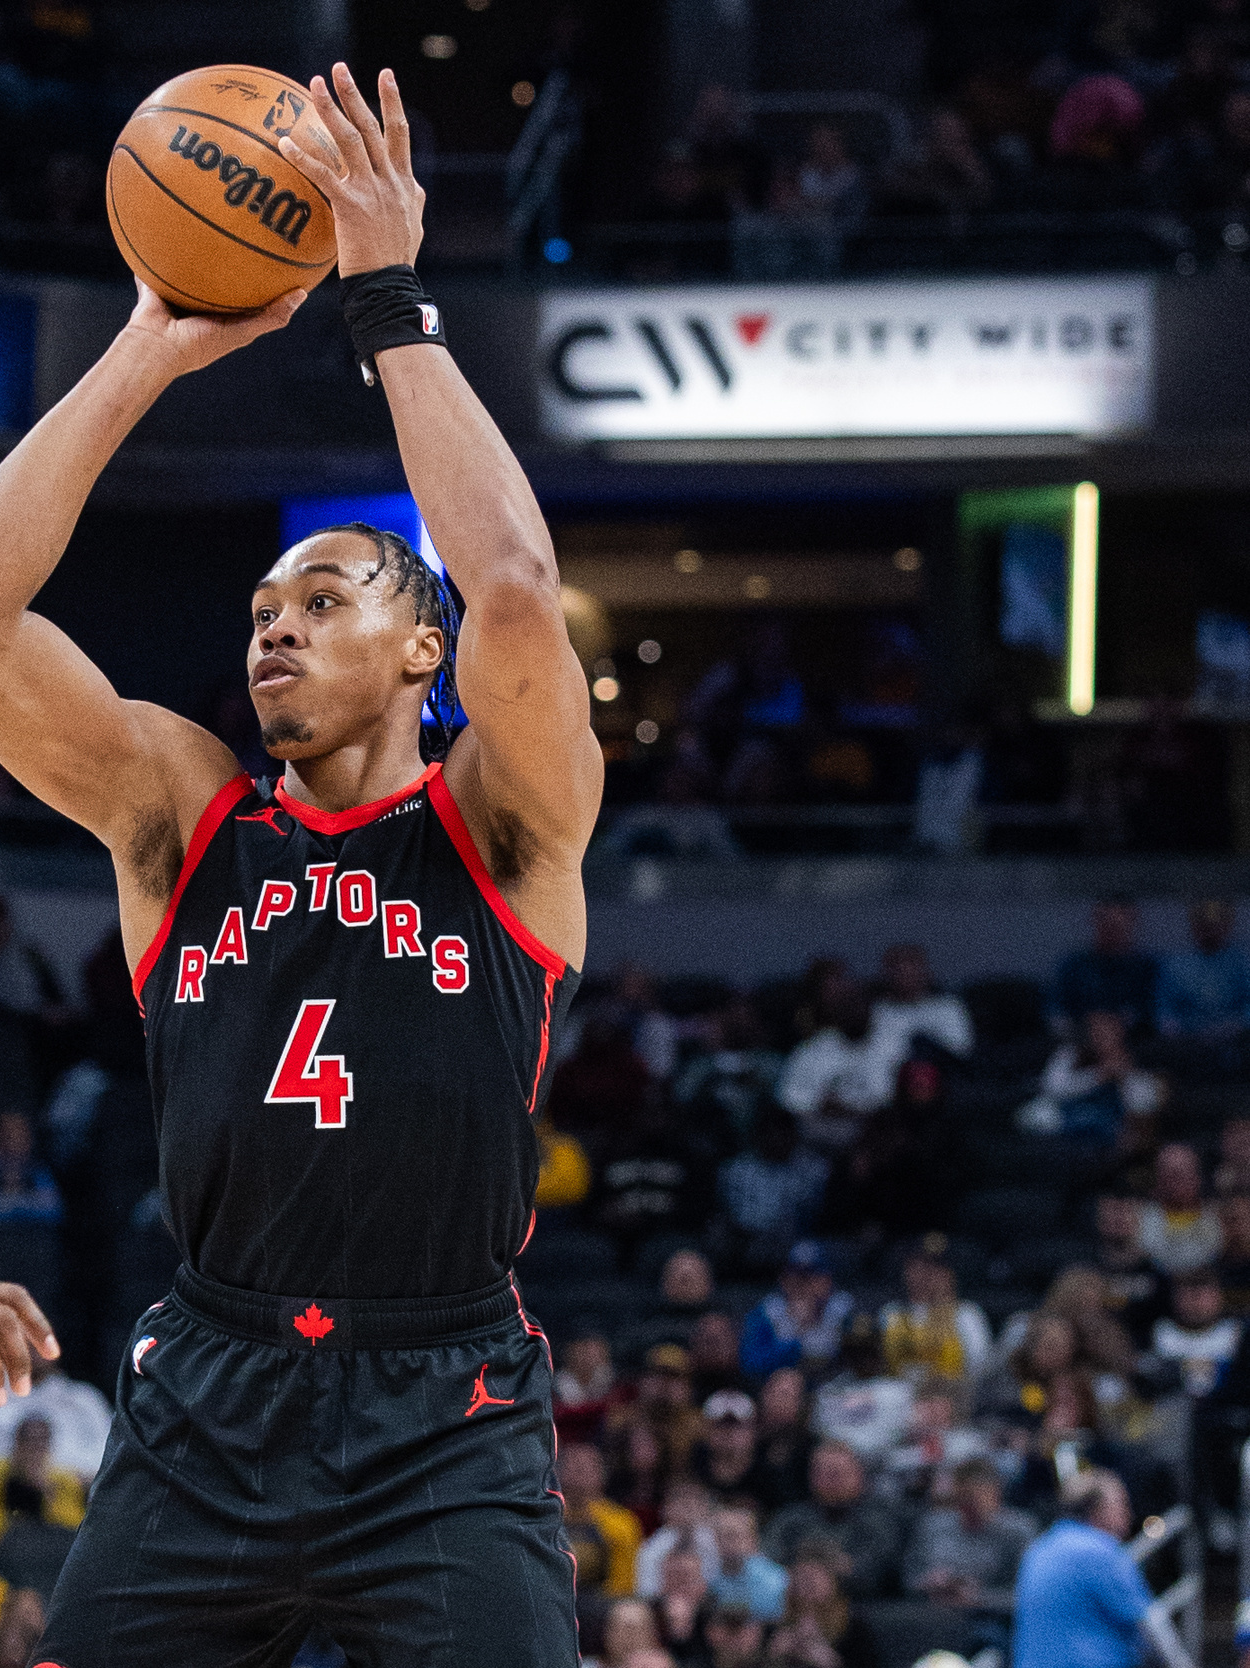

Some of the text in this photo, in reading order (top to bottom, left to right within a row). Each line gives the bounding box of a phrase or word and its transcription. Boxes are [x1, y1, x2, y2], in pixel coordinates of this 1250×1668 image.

[168, 124, 312, 248] Wilson
[551, 316, 732, 401] CW
[785, 317, 1135, 361] CITY WIDE
[175, 862, 470, 1002] RAPTORS
[264, 999, 353, 1129] 4
